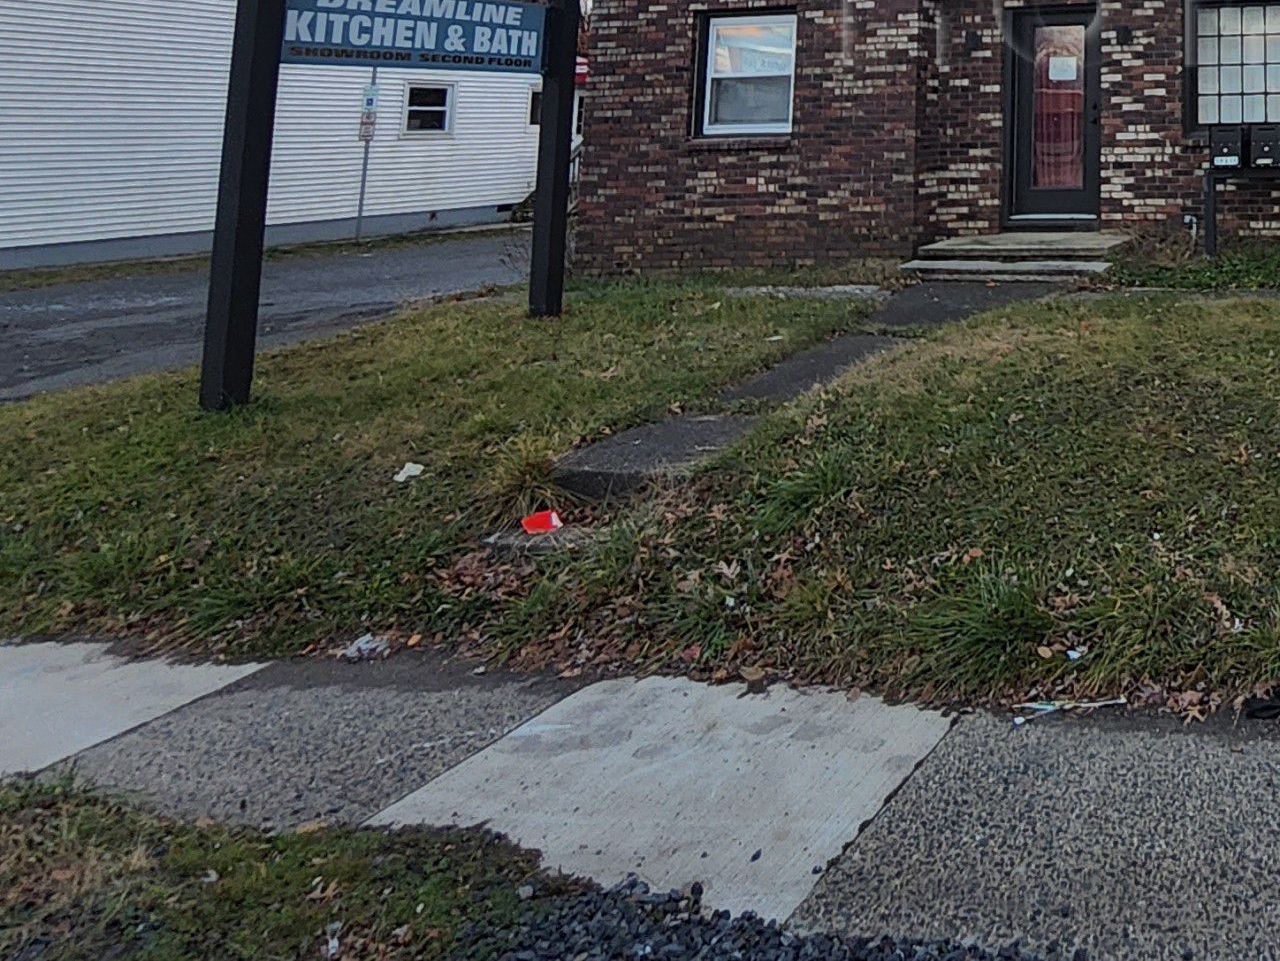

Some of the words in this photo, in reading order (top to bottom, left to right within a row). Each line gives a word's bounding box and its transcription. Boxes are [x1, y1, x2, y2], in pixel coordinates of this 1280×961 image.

[284, 9, 438, 50] KITCHEN
[444, 24, 466, 52] &
[473, 25, 537, 57] BATH
[289, 45, 412, 62] SHOWROOM
[418, 52, 485, 66] SECOND
[487, 57, 532, 68] FLOOR
